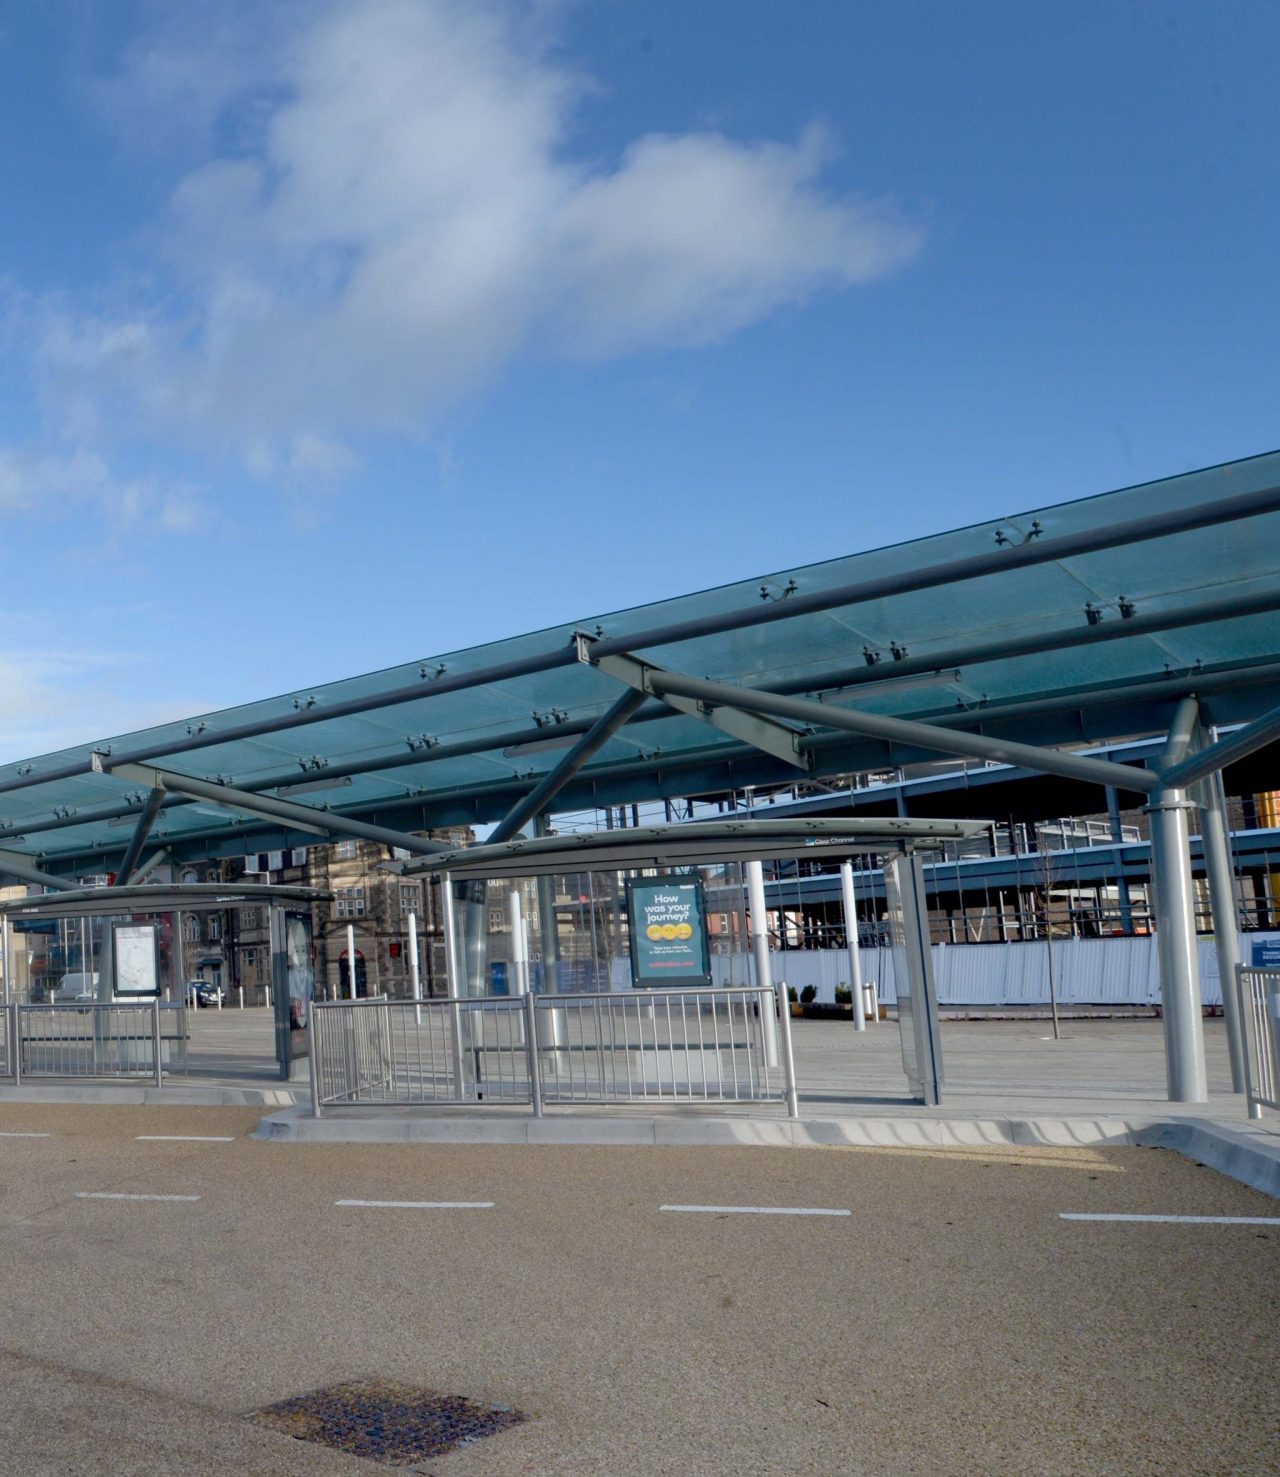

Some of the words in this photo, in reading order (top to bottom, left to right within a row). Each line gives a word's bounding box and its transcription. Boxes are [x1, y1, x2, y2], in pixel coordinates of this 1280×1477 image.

[654, 894, 679, 904] How
[644, 905, 666, 913] was
[668, 903, 691, 914] your
[647, 911, 690, 924] journey?
